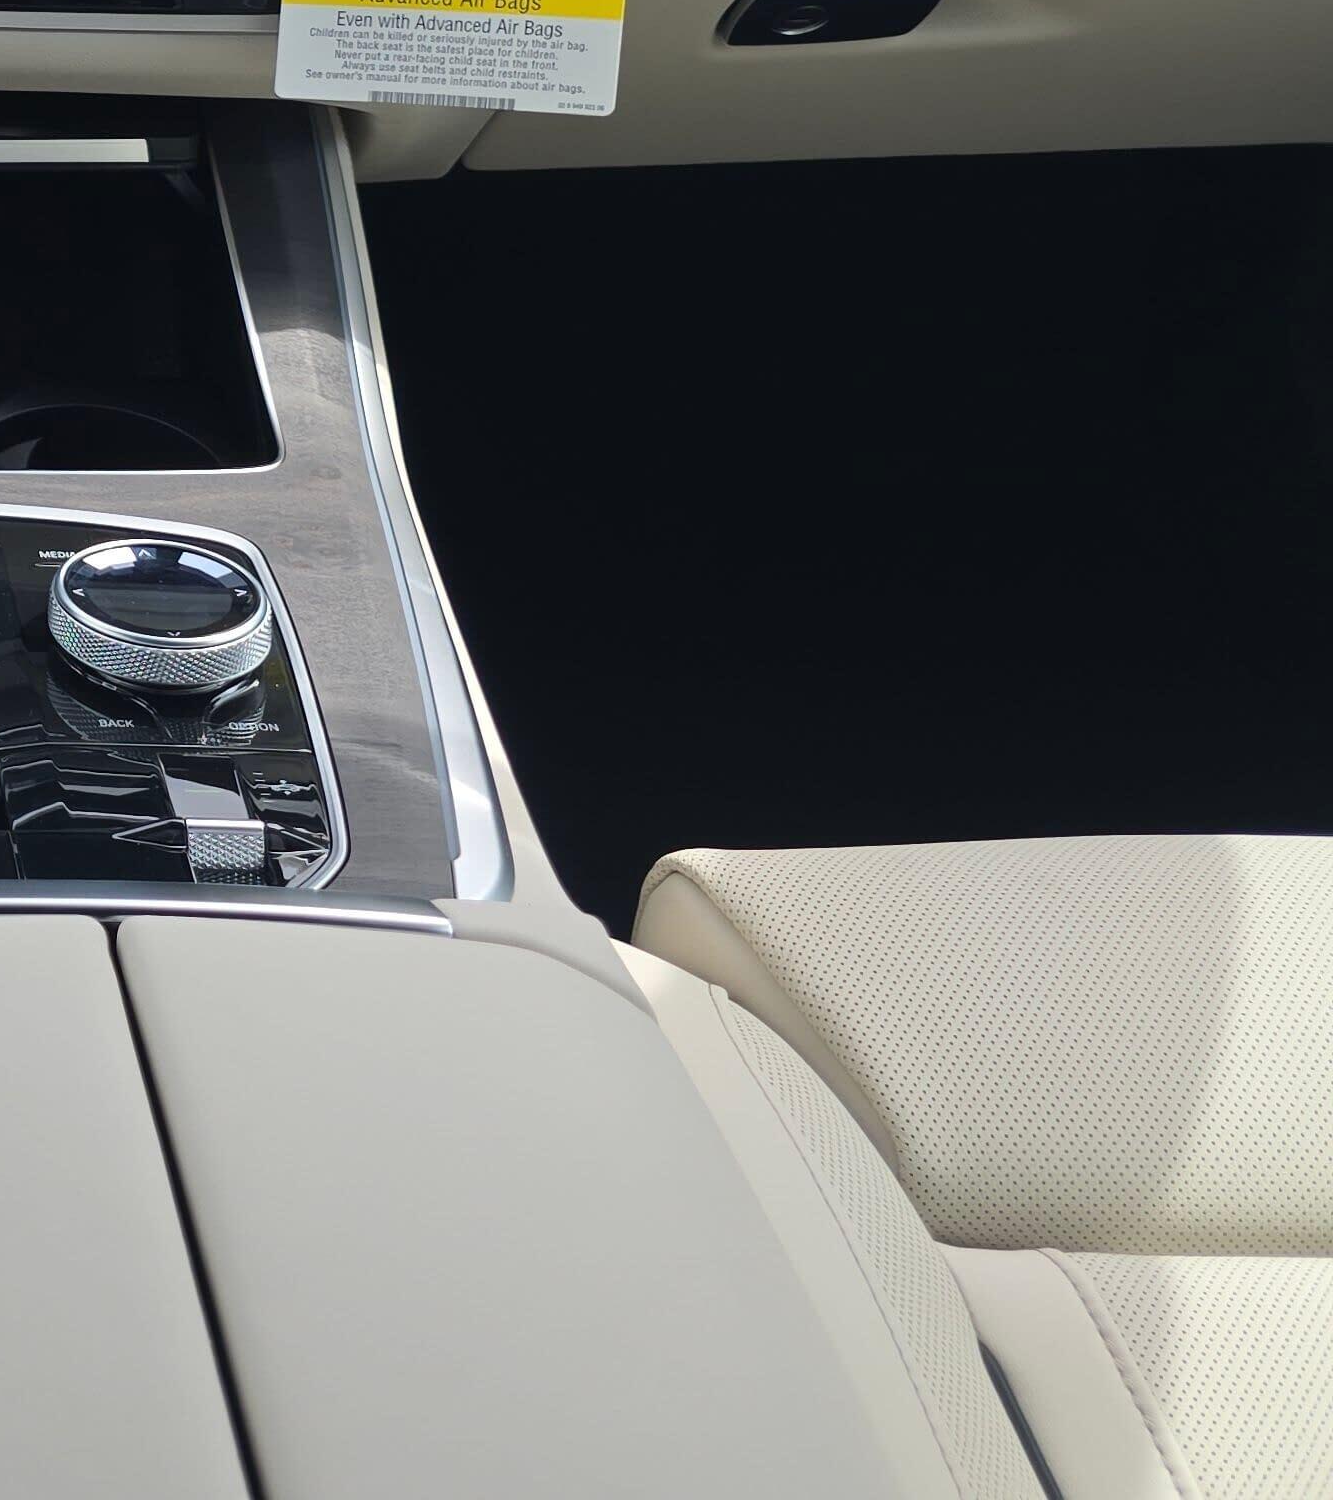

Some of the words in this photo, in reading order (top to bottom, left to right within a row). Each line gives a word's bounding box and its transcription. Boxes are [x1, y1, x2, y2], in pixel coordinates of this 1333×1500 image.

[337, 11, 372, 27] Even
[378, 13, 410, 29] with
[415, 15, 491, 33] Advanced
[496, 19, 521, 35] Air
[525, 20, 563, 40] Bags
[310, 27, 349, 38] Children
[353, 31, 369, 39] can
[373, 30, 384, 40] be
[388, 31, 413, 41] killed
[416, 34, 427, 42] or
[430, 33, 474, 46] seriously
[478, 36, 513, 47] injured
[517, 39, 529, 49] by
[532, 39, 547, 48] the
[550, 40, 564, 49] air
[568, 41, 588, 52] bag.
[337, 39, 353, 49] The
[357, 41, 379, 50] back
[382, 42, 402, 51] seat
[406, 43, 413, 52] is
[417, 44, 432, 53] the
[436, 45, 464, 54] safest
[468, 46, 494, 56] place
[498, 47, 511, 57] for
[515, 49, 559, 60] children.
[334, 50, 362, 59] Never
[365, 52, 381, 61] put
[384, 53, 390, 61] a
[393, 54, 445, 65] rear-facing
[449, 56, 472, 66] child
[476, 58, 497, 67] seat
[499, 59, 509, 68] in
[513, 60, 528, 69] the
[531, 61, 559, 71] front.
[342, 61, 375, 72] Always
[399, 64, 419, 73] seat
[422, 65, 446, 75] belts
[449, 67, 467, 76] and
[470, 68, 494, 77] child
[498, 70, 548, 81] restraints.
[305, 69, 322, 78] See
[325, 72, 363, 80] owner's
[366, 74, 401, 83] manual
[404, 74, 417, 83] for
[421, 77, 446, 85] more
[450, 77, 507, 89] information
[510, 82, 539, 91] about
[542, 83, 555, 92] air
[559, 84, 586, 95] bags.
[98, 719, 135, 728] BACK
